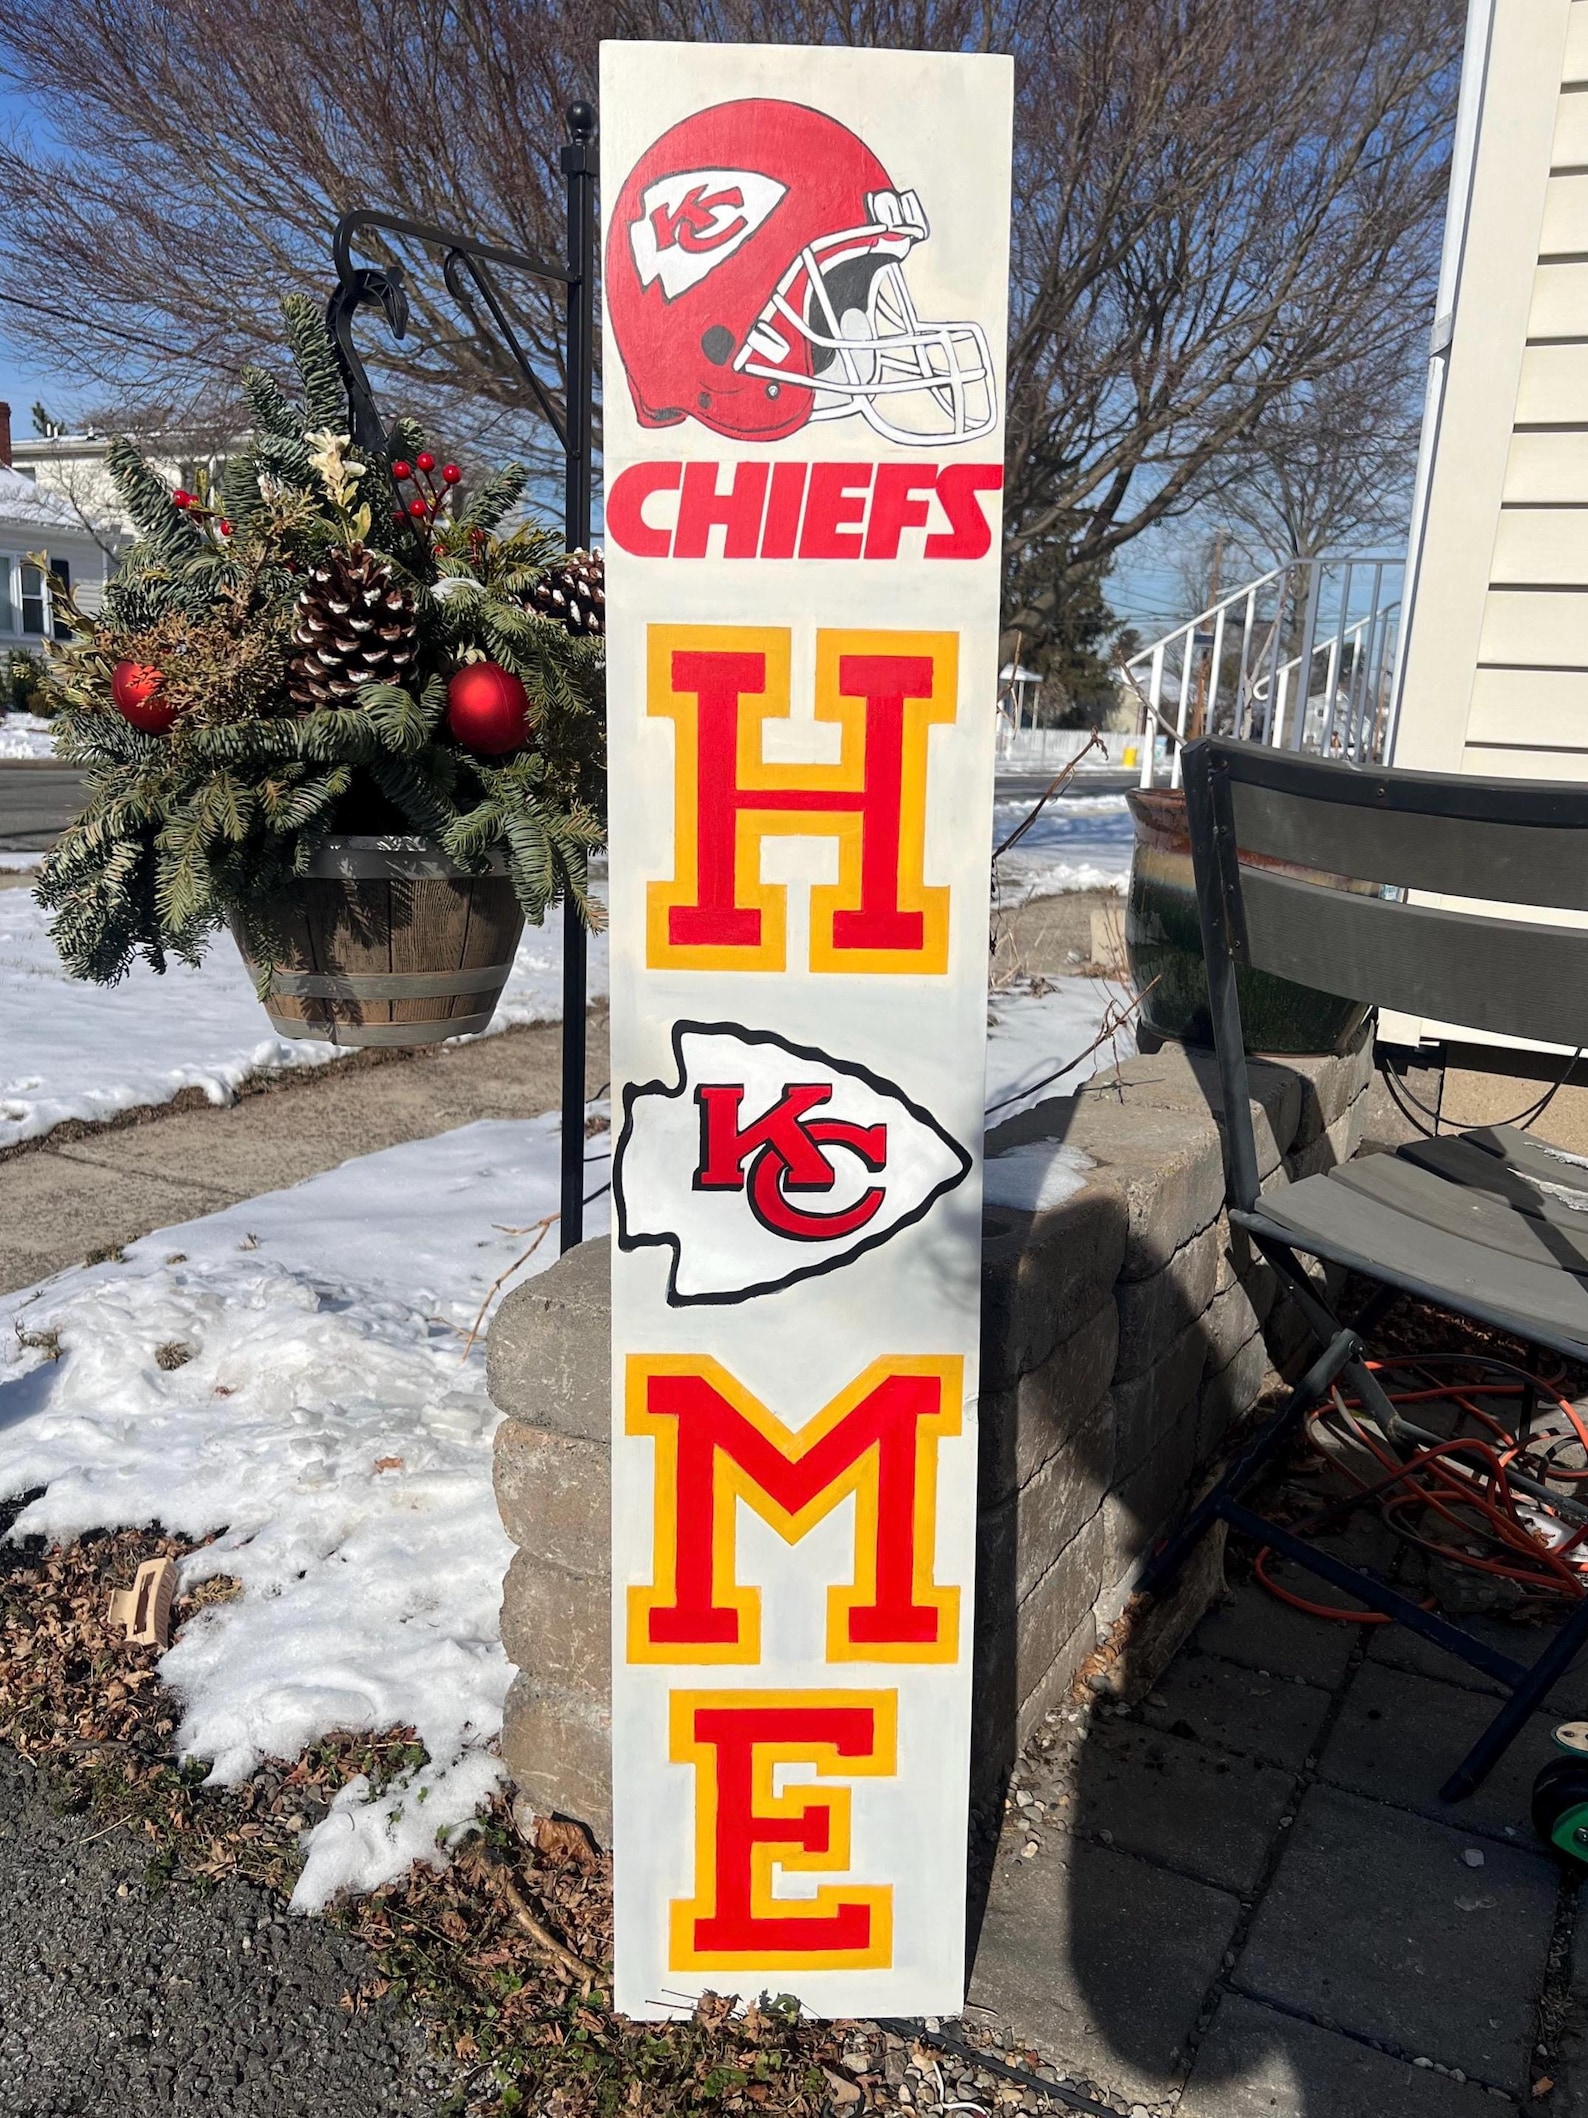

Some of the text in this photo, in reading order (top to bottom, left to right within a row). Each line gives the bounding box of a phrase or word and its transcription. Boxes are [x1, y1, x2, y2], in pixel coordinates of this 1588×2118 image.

[649, 183, 748, 253] KC
[606, 461, 1003, 560] CHIEFS
[692, 1084, 887, 1241] KC
